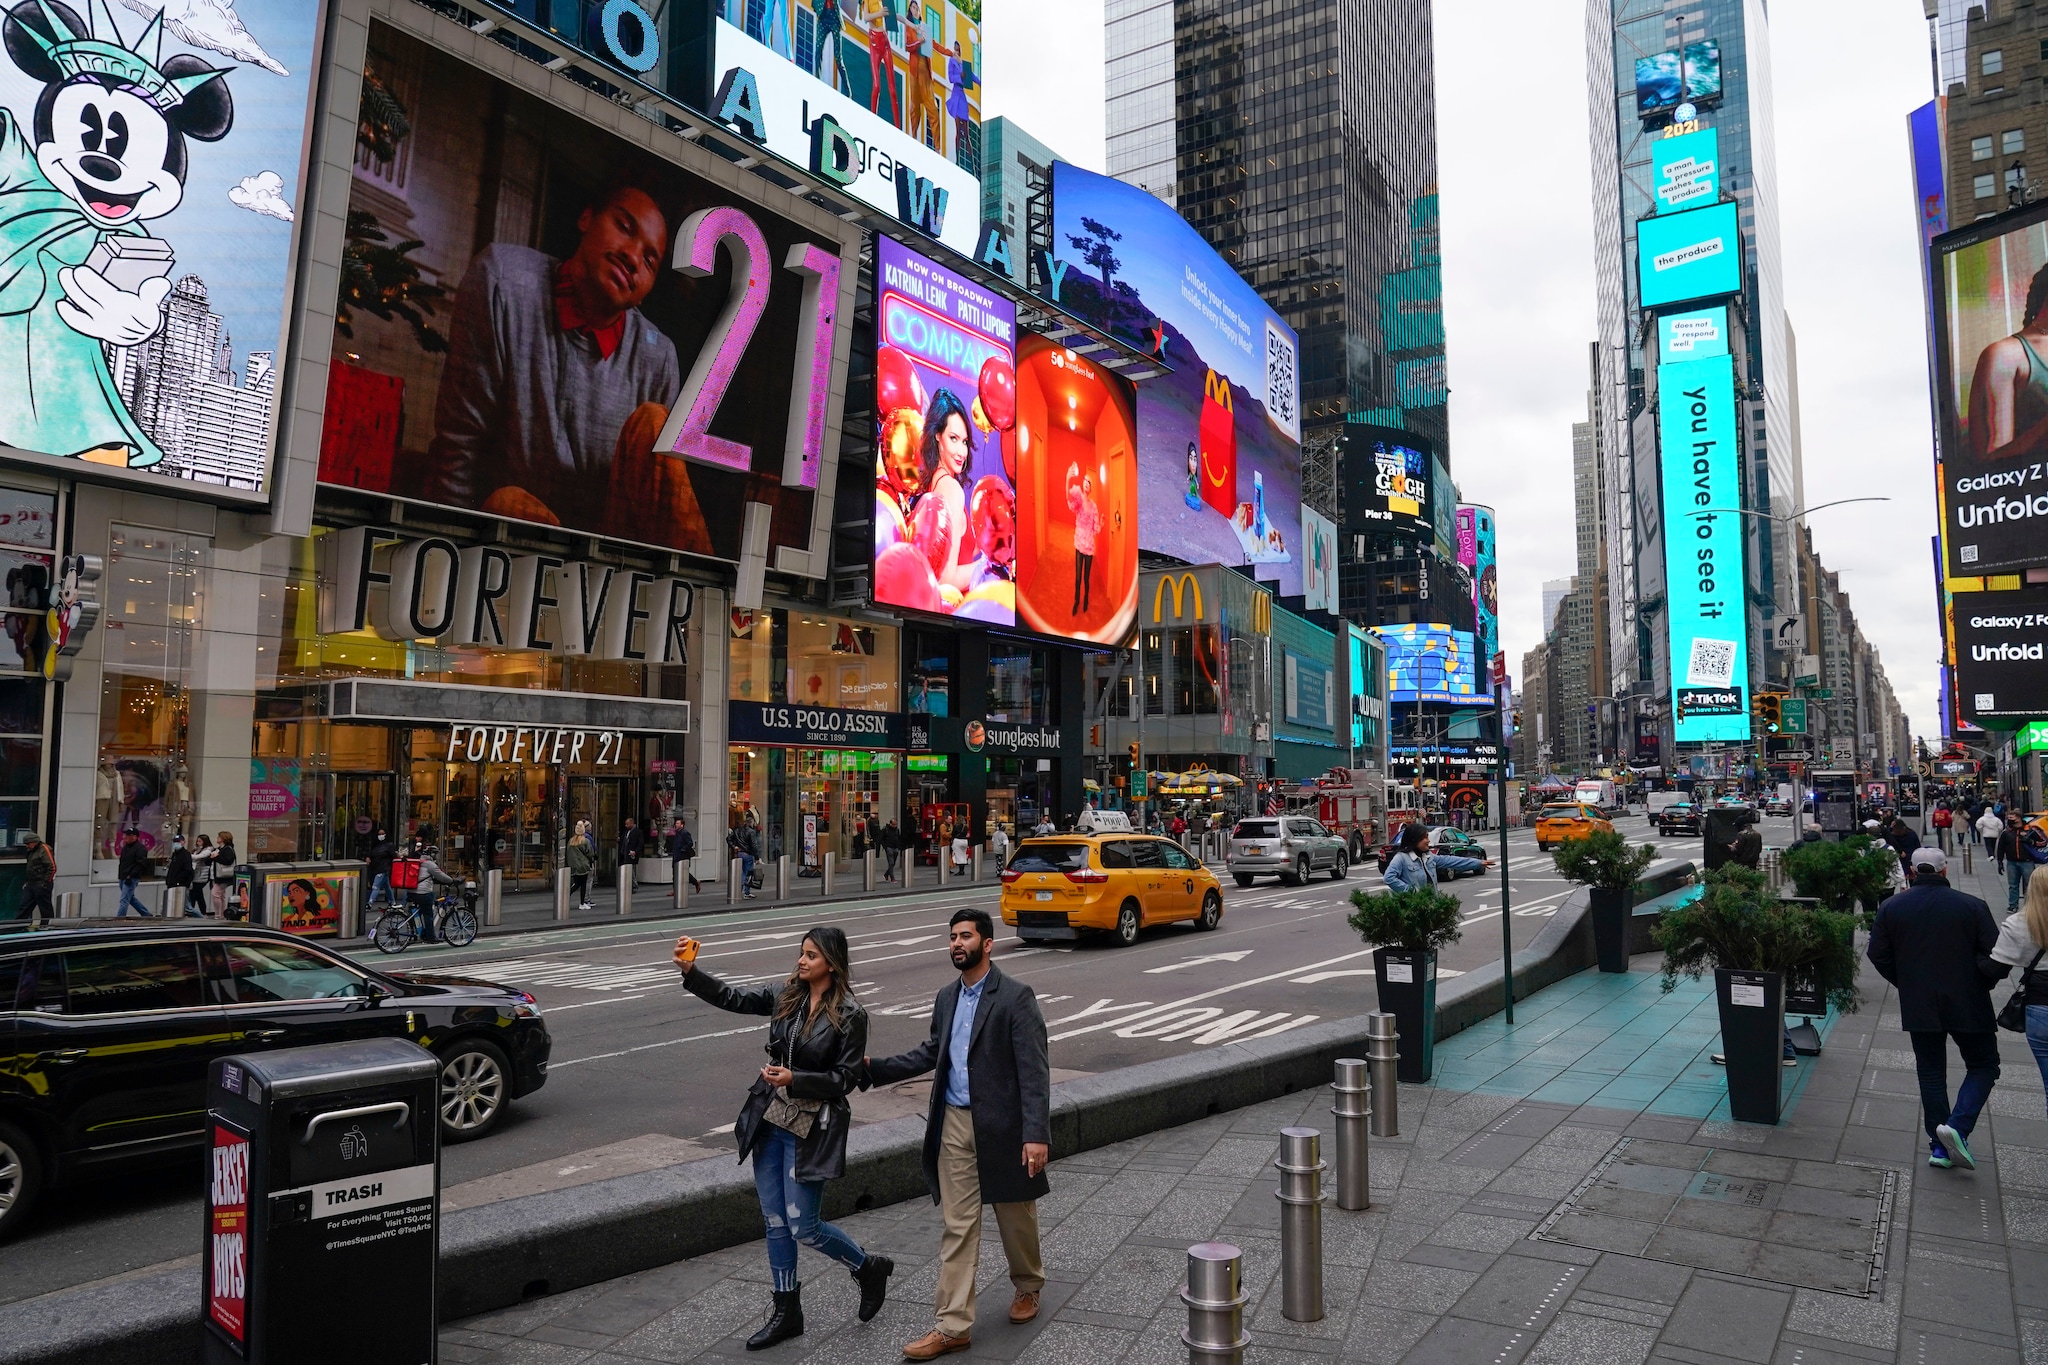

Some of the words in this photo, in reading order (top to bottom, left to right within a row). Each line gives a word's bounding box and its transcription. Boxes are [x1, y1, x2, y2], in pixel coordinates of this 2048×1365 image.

[1664, 119, 1698, 139] 2021
[1674, 161, 1692, 171] man
[1674, 164, 1710, 181] pressure
[1661, 180, 1692, 194] washes
[1672, 185, 1708, 202] produce.
[1658, 256, 1675, 266] the
[1677, 243, 1719, 263] produce
[907, 258, 929, 277] NOW
[931, 271, 945, 285] ON
[946, 278, 993, 309] BROADWAY
[885, 263, 924, 300] KATRINA
[925, 283, 947, 311] LENK
[957, 299, 980, 327] PATTI
[981, 311, 1011, 342] LUPONE
[1185, 264, 1208, 296] Unlock
[1208, 289, 1222, 311] your
[1222, 299, 1238, 325] inner
[1238, 313, 1251, 337] hero
[1181, 279, 1201, 311] inside
[1202, 303, 1219, 329] every
[1219, 317, 1237, 346] Happy
[1682, 330, 1715, 338] respond
[656, 205, 843, 488] 21
[1682, 386, 1707, 433] you
[1375, 463, 1406, 478] van
[1692, 441, 1717, 506] have
[1956, 468, 2028, 493] Galaxy
[2029, 463, 2042, 481] Z
[1375, 473, 1425, 498] GGH
[1376, 488, 1400, 498] Exhibit
[1365, 509, 1382, 519] Pier
[1696, 513, 1718, 540] to
[1462, 529, 1474, 558] Love
[1418, 558, 1429, 600] 1500
[1697, 548, 1715, 593] see
[330, 525, 695, 665] FOREVER
[1700, 601, 1724, 619] it
[1970, 615, 2023, 629] Galaxy
[2024, 614, 2034, 626] Z
[1778, 638, 1800, 646] ONLY
[1971, 642, 2043, 662] Unfold
[1359, 694, 1369, 716] OLD
[1370, 696, 1382, 720] NAVY
[1695, 693, 1737, 704] TikTok
[762, 707, 791, 728] U.S.
[795, 709, 841, 731] POLO
[844, 713, 889, 734] ASSN.
[911, 725, 922, 733] U.S.
[447, 725, 586, 764] FOREVER
[596, 731, 624, 765] 21
[806, 732, 829, 741] SINCE
[830, 733, 847, 742] 1890
[988, 725, 1040, 752] sunglass
[1040, 727, 1061, 749] hut
[1450, 757, 1476, 765] Huskies
[1835, 750, 1852, 759] 25
[252, 795, 286, 803] COLLECTION
[260, 788, 269, 796] YOU
[251, 802, 278, 812] DONATE
[1102, 817, 1122, 826] POOP
[281, 917, 308, 929] TAND
[309, 916, 339, 927] WITH
[325, 1182, 383, 1206] TRASH
[327, 1221, 340, 1230] For
[341, 1212, 382, 1228] Everything
[382, 1208, 405, 1219] Times
[405, 1203, 432, 1214] Square
[385, 1218, 401, 1228] Visit
[402, 1212, 432, 1225] TSQ.org
[325, 1229, 397, 1251] @TimesSquareNYC
[397, 1223, 432, 1236] @TsqArts
[213, 1232, 245, 1299] BOYS
